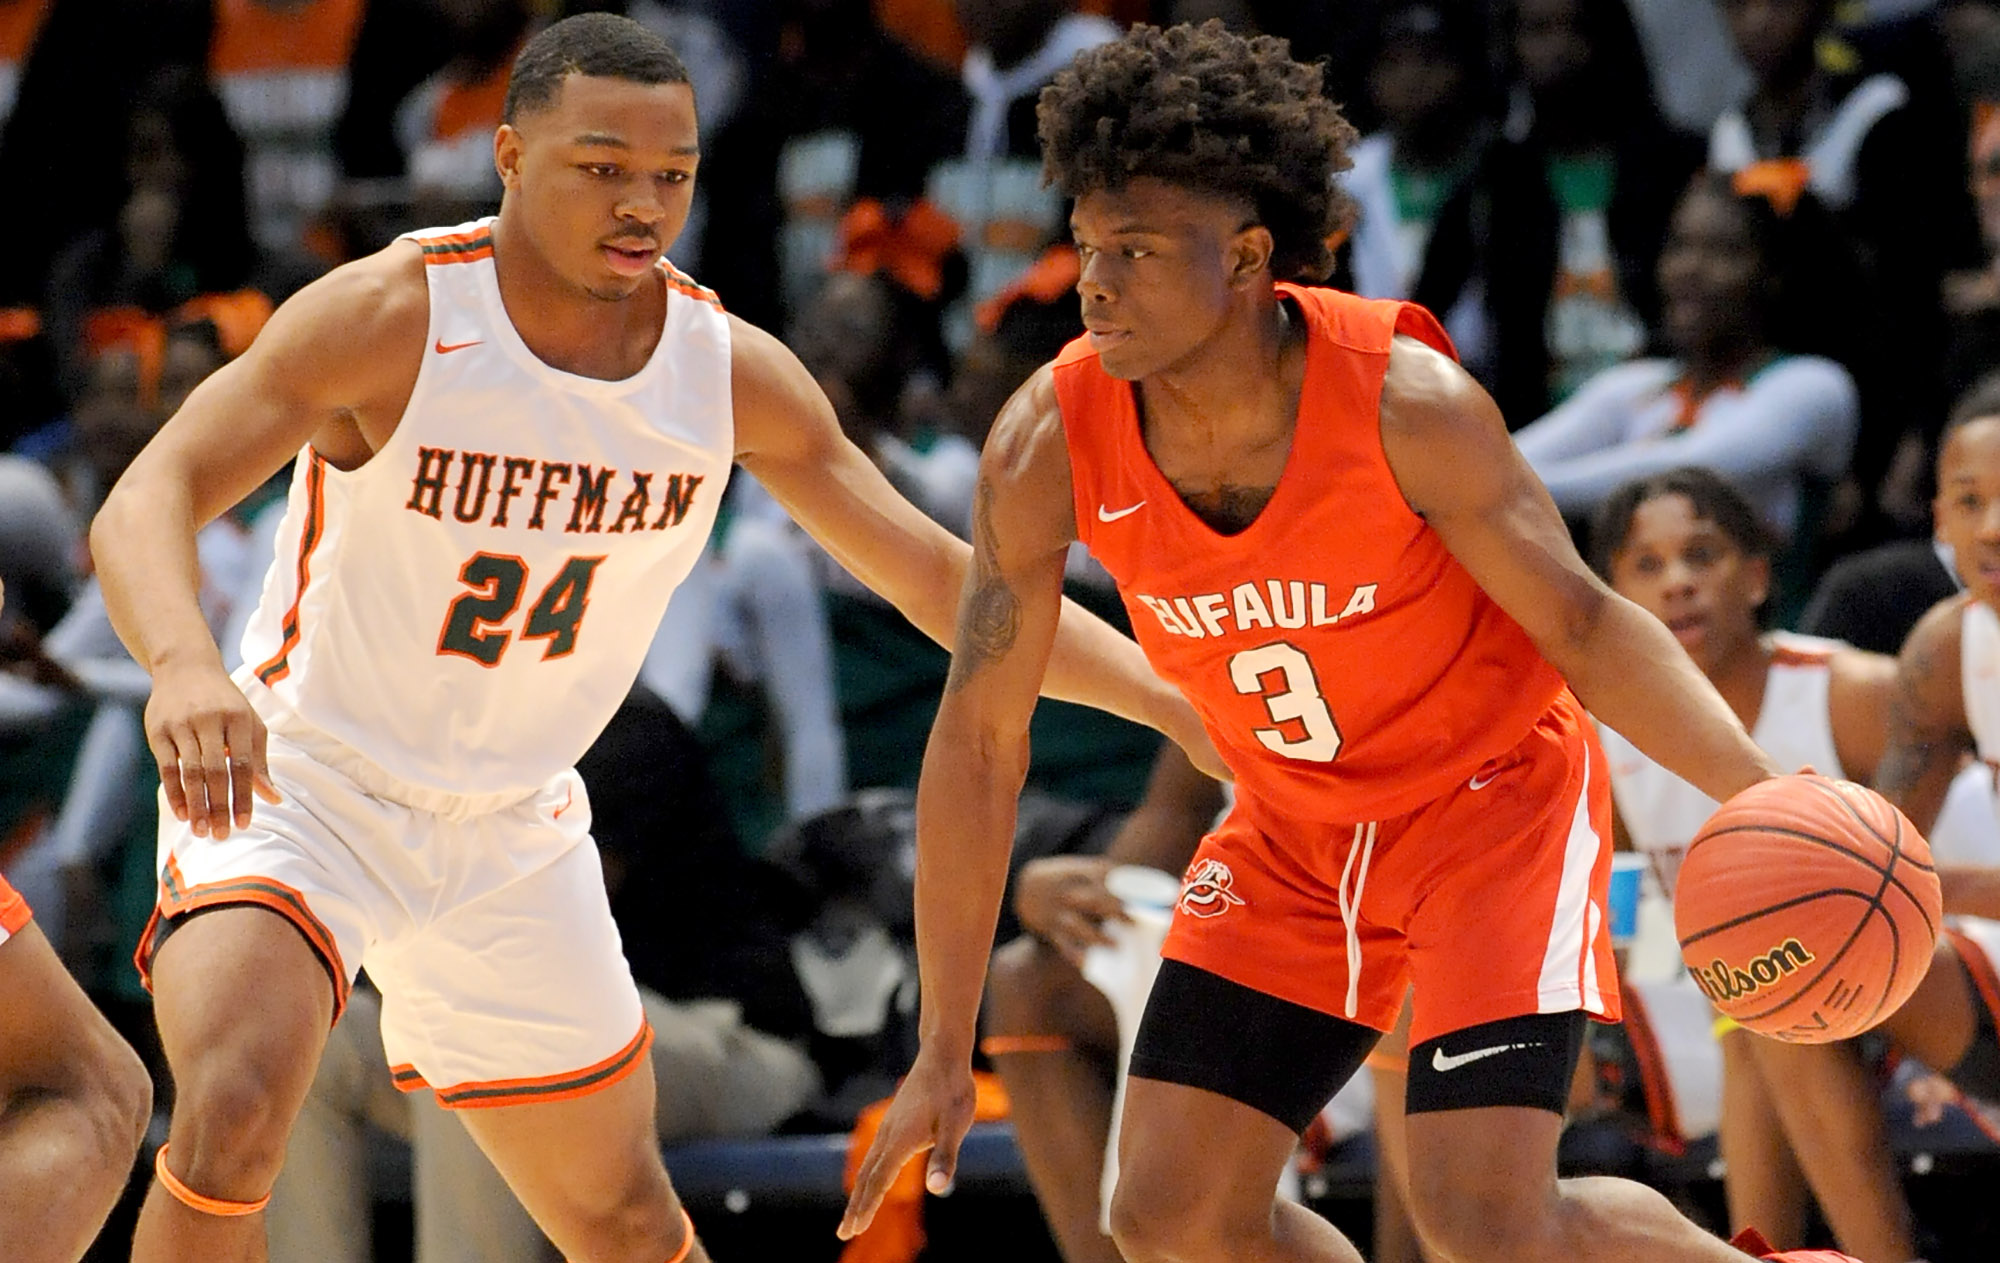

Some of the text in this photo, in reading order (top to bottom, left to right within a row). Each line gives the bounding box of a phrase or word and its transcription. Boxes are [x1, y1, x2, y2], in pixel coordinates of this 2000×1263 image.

[405, 446, 704, 533] HUFFMAN
[436, 551, 609, 668] 24
[1136, 579, 1378, 639] EUFAULA
[1227, 639, 1344, 763] 3
